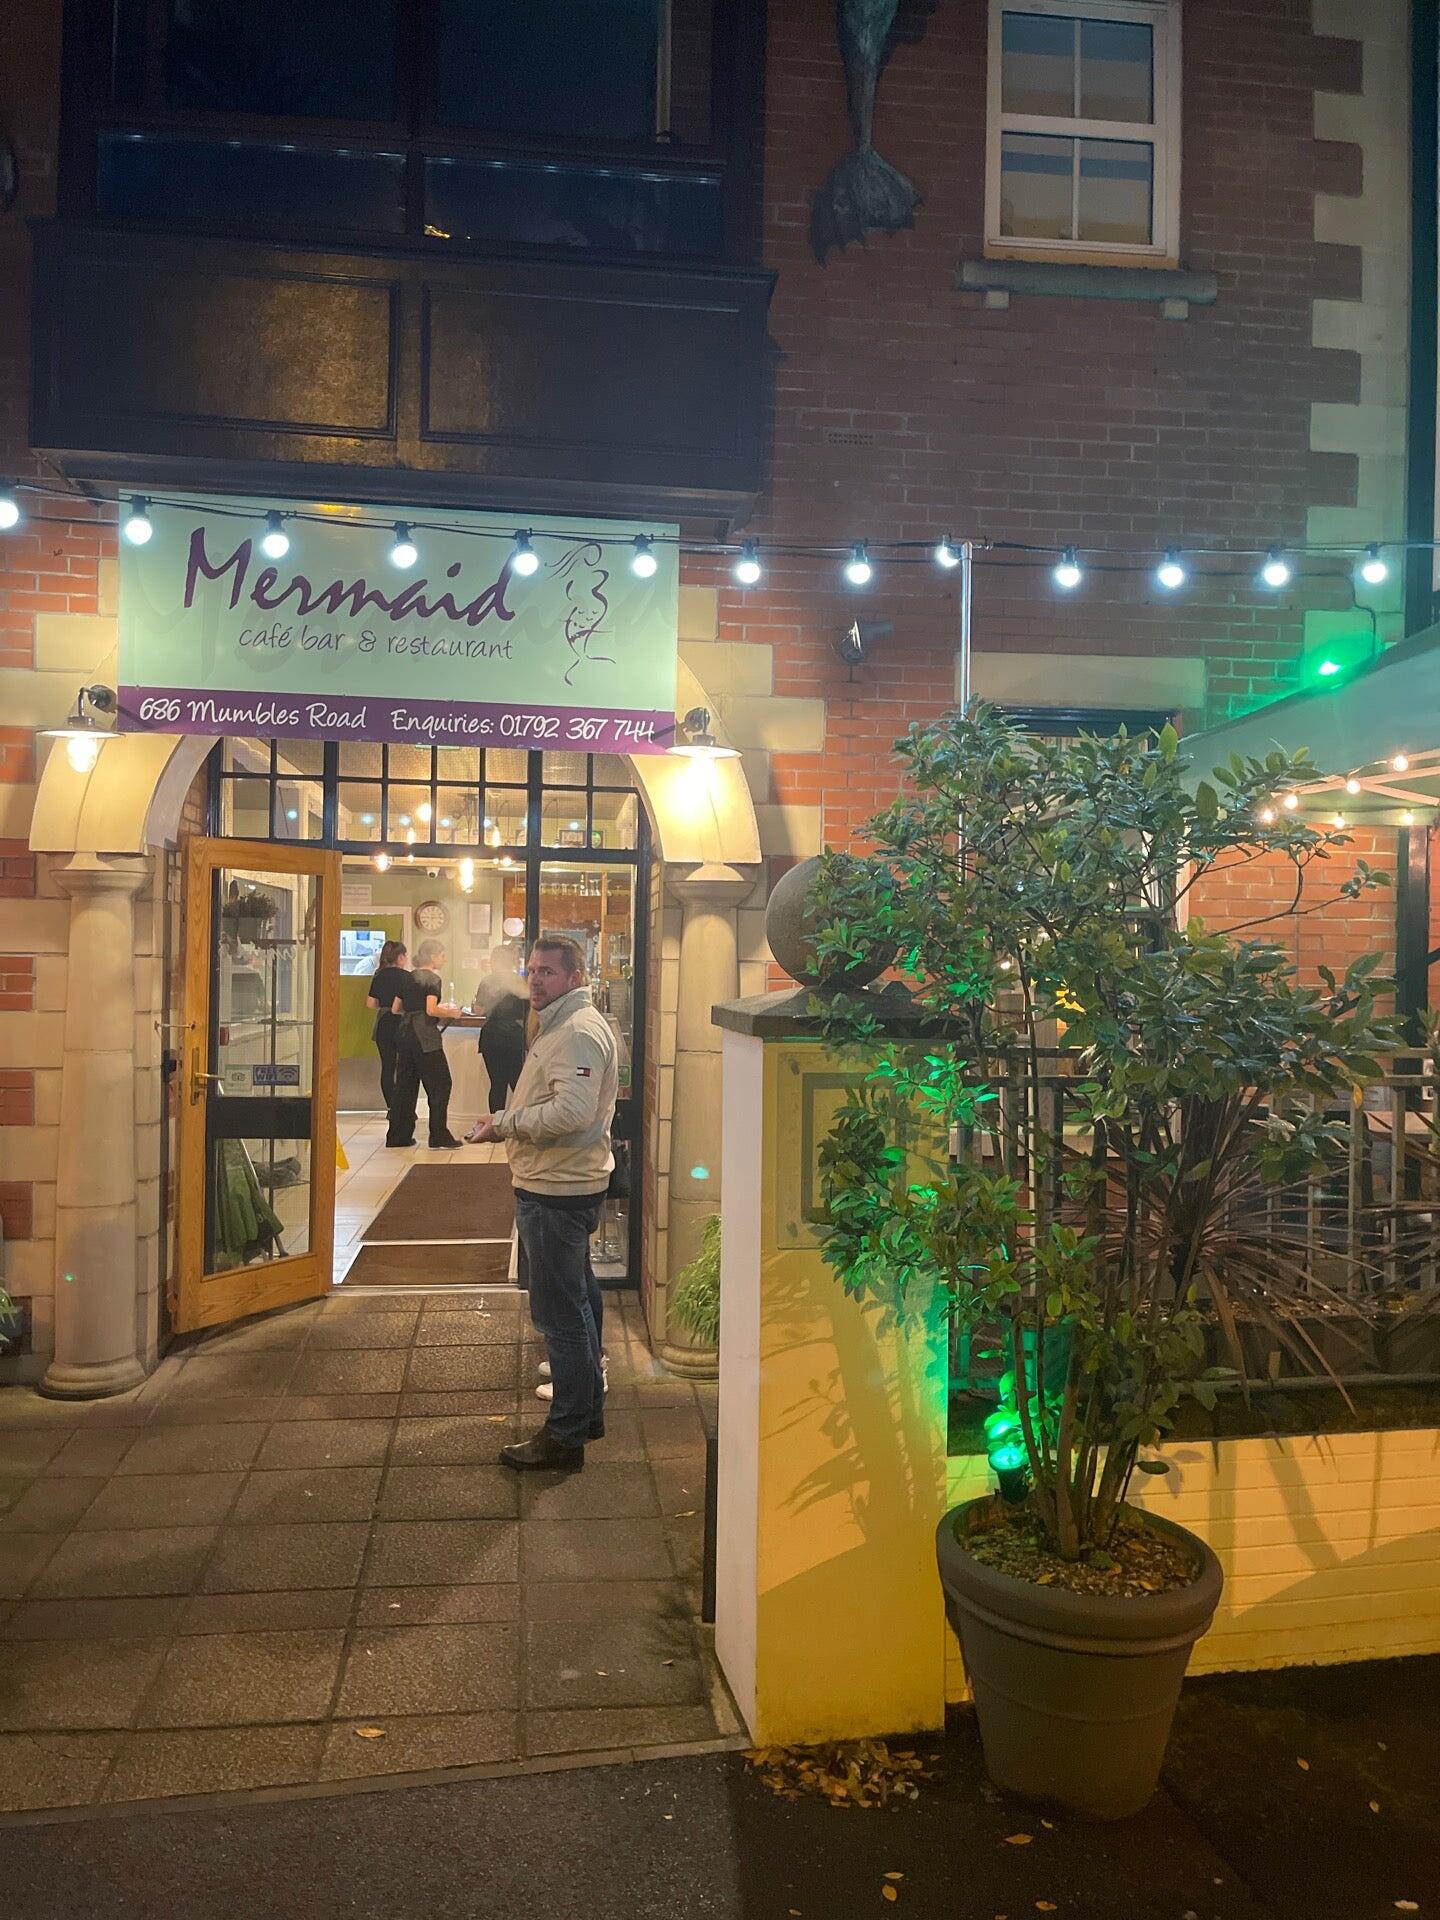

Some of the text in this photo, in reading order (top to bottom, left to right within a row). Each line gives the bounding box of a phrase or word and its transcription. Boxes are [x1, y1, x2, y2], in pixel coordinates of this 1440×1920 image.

[184, 526, 516, 627] Mermaid
[239, 622, 514, 660] café bar & restaurant
[139, 697, 656, 744] 686 Mumbles Road Enquiries: 01792 367 744
